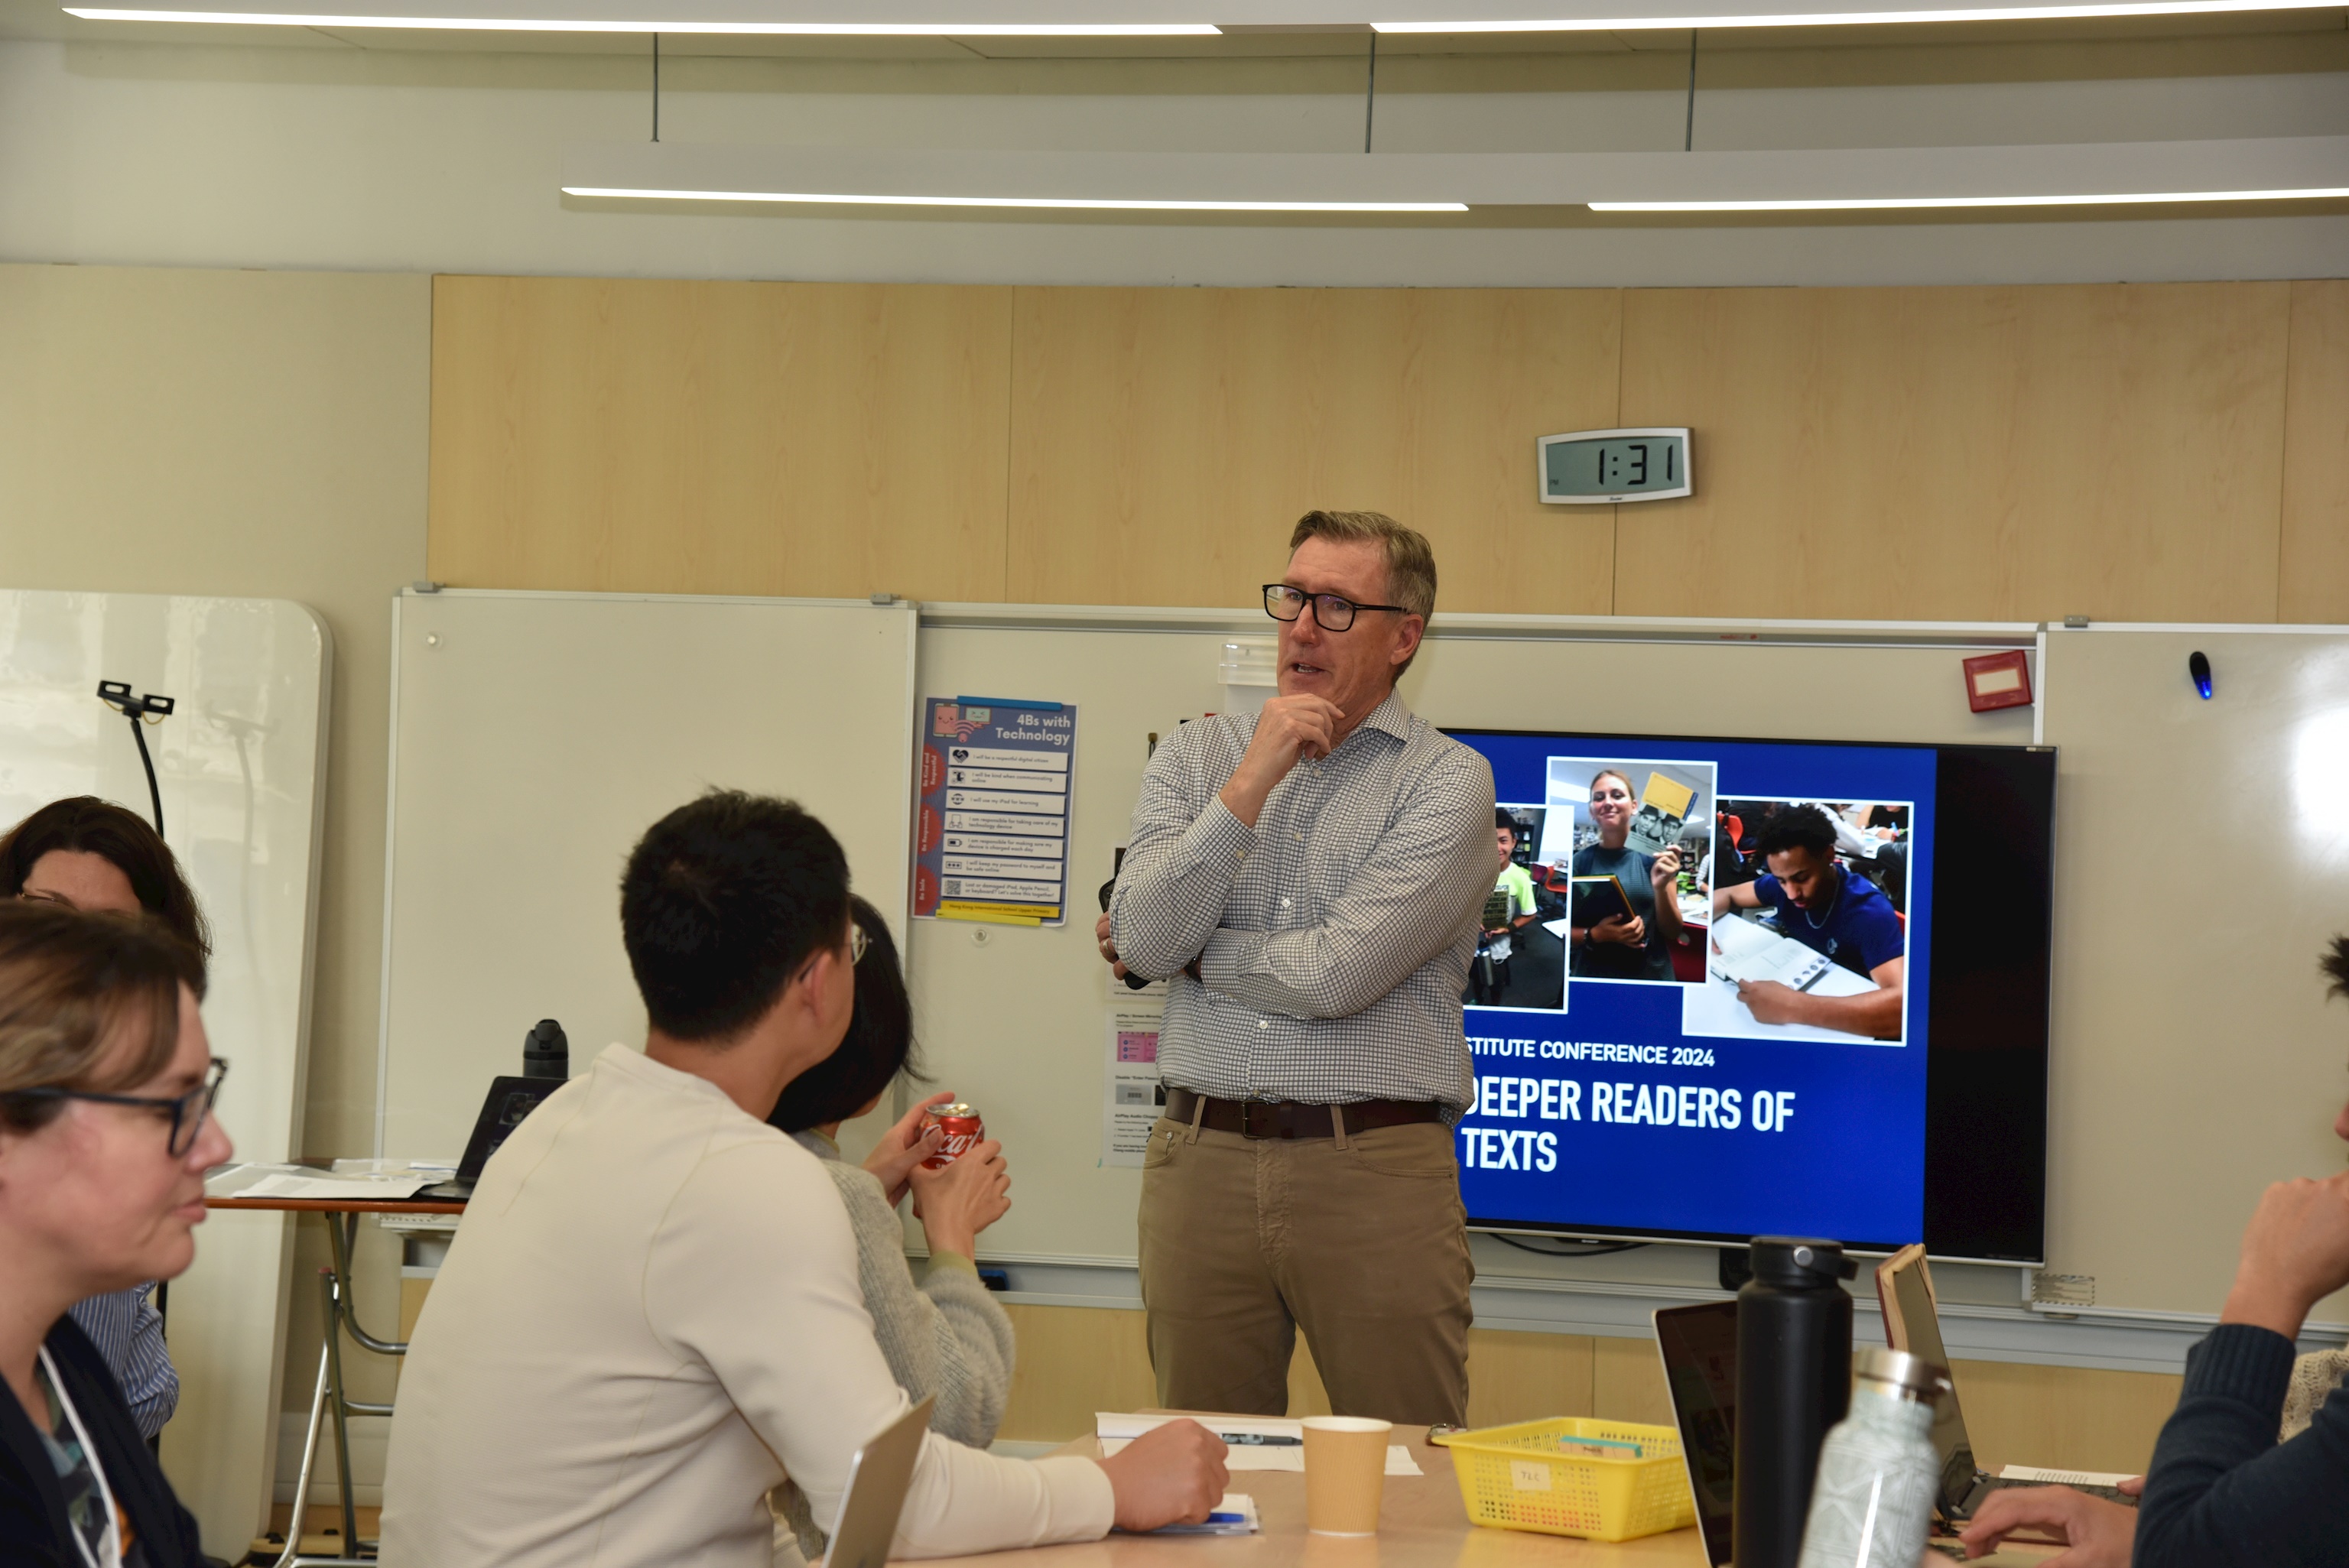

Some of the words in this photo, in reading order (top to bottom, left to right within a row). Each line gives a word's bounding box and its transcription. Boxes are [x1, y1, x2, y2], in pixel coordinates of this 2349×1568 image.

[1599, 444, 1673, 485] 1:31
[996, 728, 1071, 745] Technology
[1017, 714, 1039, 726] 4Bs
[1042, 716, 1071, 727] with
[1539, 1040, 1668, 1065] CONFERENCE
[1672, 1047, 1715, 1066] 2024
[1591, 1082, 1742, 1130] READERS
[1752, 1089, 1795, 1132] OF
[1461, 1127, 1558, 1173] TEXTS
